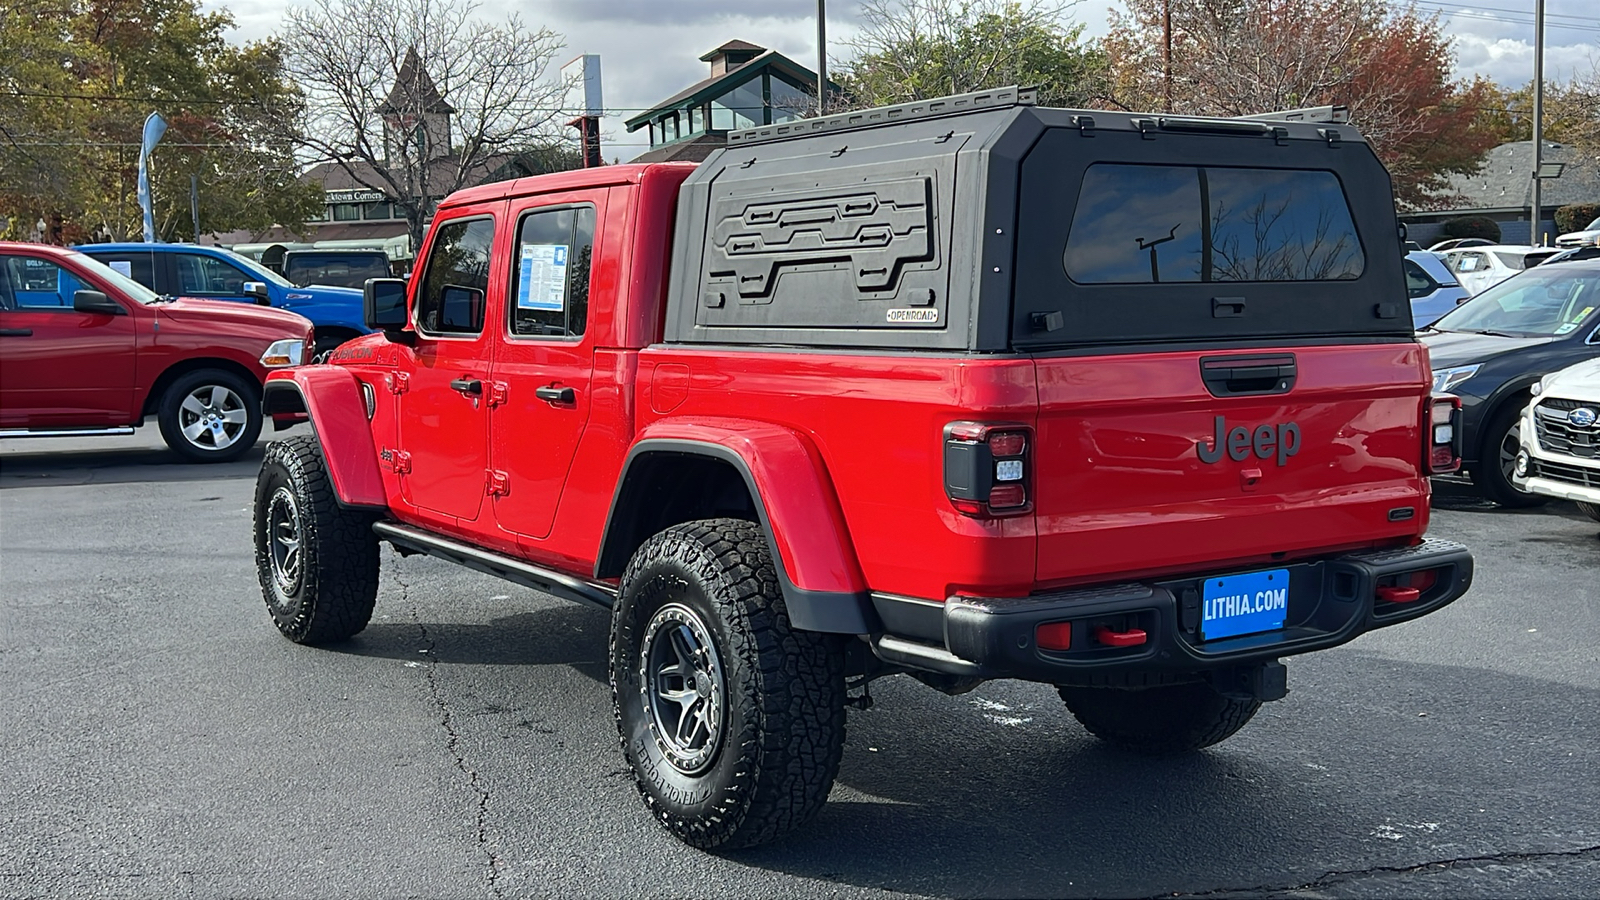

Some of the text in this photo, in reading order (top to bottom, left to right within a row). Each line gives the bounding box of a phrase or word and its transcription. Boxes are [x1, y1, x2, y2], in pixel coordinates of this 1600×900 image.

[354, 192, 382, 200] Corners
[890, 310, 933, 321] OPENROAD
[1196, 415, 1301, 467] Jeep
[1204, 588, 1286, 621] LITHIA.COM
